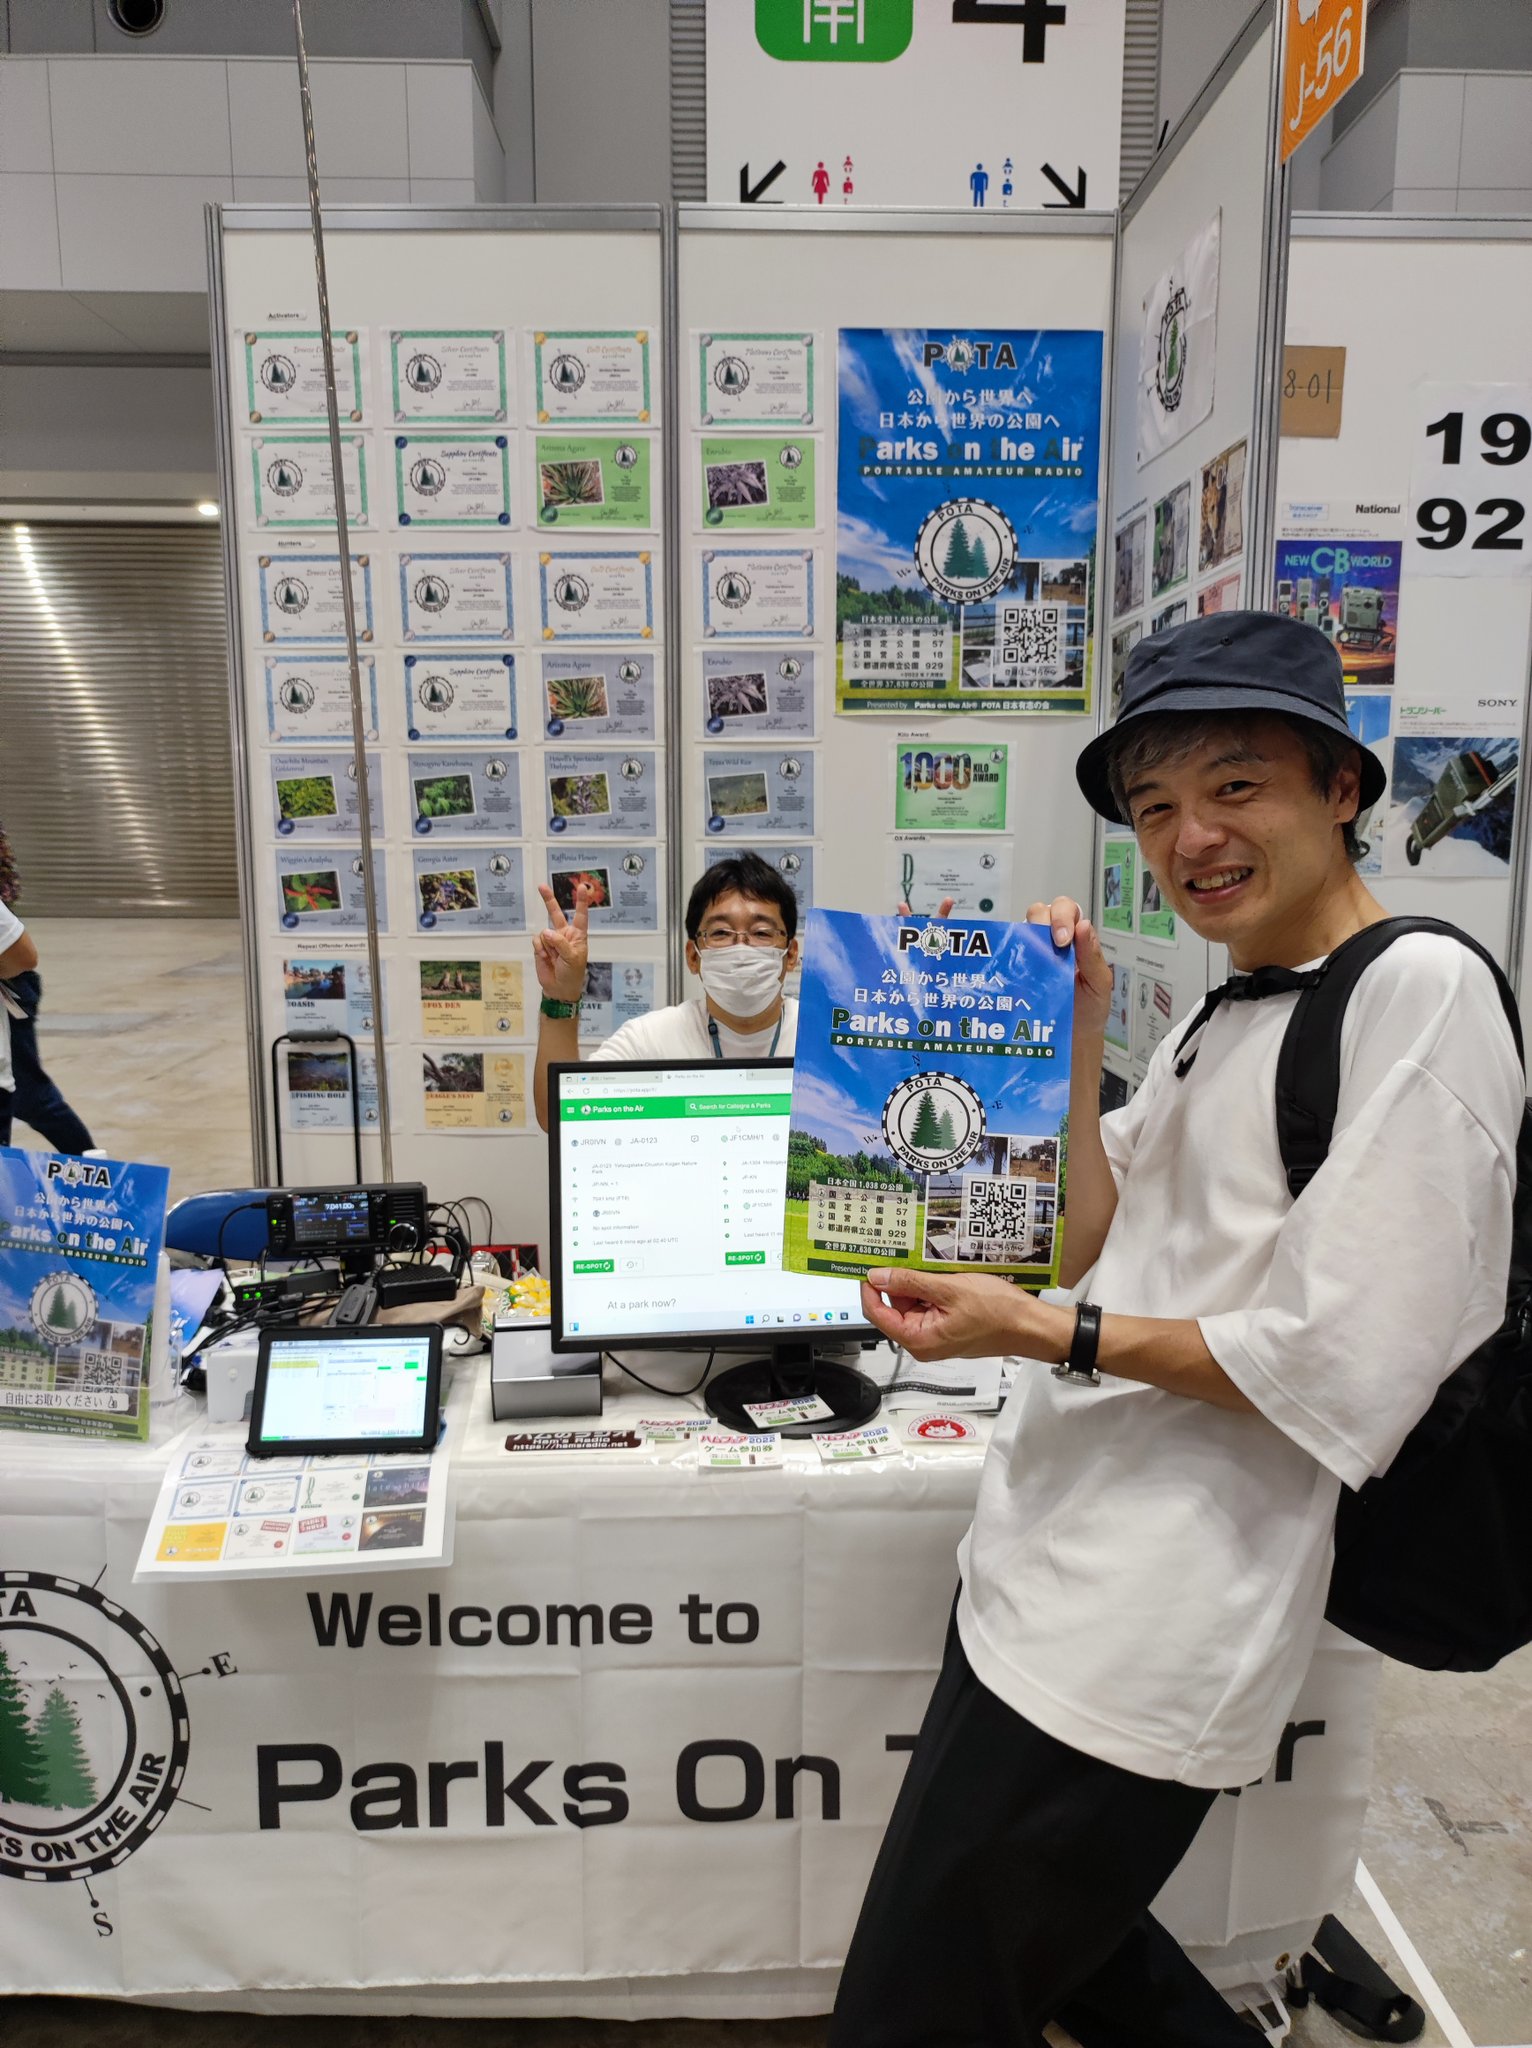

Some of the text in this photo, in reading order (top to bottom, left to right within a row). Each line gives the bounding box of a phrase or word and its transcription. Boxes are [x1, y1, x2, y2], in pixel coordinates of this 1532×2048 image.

[1289, 6, 1352, 131] J-56
[922, 339, 1017, 372] POTA
[1425, 411, 1532, 466] 19
[858, 436, 938, 461] Parks
[946, 441, 981, 461] on
[991, 436, 1035, 461] the
[863, 466, 1082, 477] PORTABLE AMATEUR RADIO
[937, 503, 974, 522] POTA
[1355, 504, 1401, 514] National
[1415, 497, 1526, 551] 92
[1284, 548, 1392, 575] NEW CB WORLD
[931, 557, 1011, 600] PARKS ON THE AIR
[866, 701, 898, 709] Presented
[899, 701, 908, 710] by
[1477, 699, 1518, 708] SONY
[973, 763, 989, 773] KILO
[972, 773, 999, 783] AWARD
[898, 924, 992, 959] POTA
[881, 968, 1006, 989] 公園から世界へ
[427, 1001, 444, 1009] FOX
[854, 988, 1032, 1012] 日本から世界の公園へ
[831, 1007, 910, 1036] Parks
[917, 1018, 952, 1038] on
[959, 1017, 1005, 1041] the
[836, 1035, 1053, 1057] PORTABLE AMATEUR RADIO
[906, 1077, 943, 1094] POTA
[592, 1105, 613, 1113] Parks
[622, 1105, 634, 1113] the
[635, 1104, 645, 1112] Air
[629, 1136, 658, 1145] JA-0123
[897, 1130, 979, 1170] PARKS ON THE AIR
[47, 1160, 112, 1189] POTA
[896, 1196, 909, 1205] 34
[896, 1207, 908, 1216] 57
[896, 1219, 907, 1228] 18
[57, 1231, 80, 1247] on
[85, 1231, 117, 1252] the
[888, 1229, 907, 1238] 929
[727, 1253, 754, 1263] RE-SPOT
[830, 1263, 861, 1274] Presented
[607, 1300, 619, 1310] At
[628, 1299, 650, 1311] park
[651, 1297, 677, 1308] now?
[38, 1323, 59, 1343] PARKS
[791, 1395, 817, 1406] 2022
[532, 1436, 611, 1445] Ham's Radio
[748, 1436, 776, 1444] 2022
[862, 1426, 888, 1438] 2022
[306, 1591, 760, 1648] Welcome to
[208, 1651, 238, 1679] E
[256, 1738, 840, 1832] Parks On
[31, 1841, 77, 1862] ON
[76, 1806, 137, 1855] THE
[138, 1752, 167, 1809] AIR
[93, 1911, 114, 1938] S
